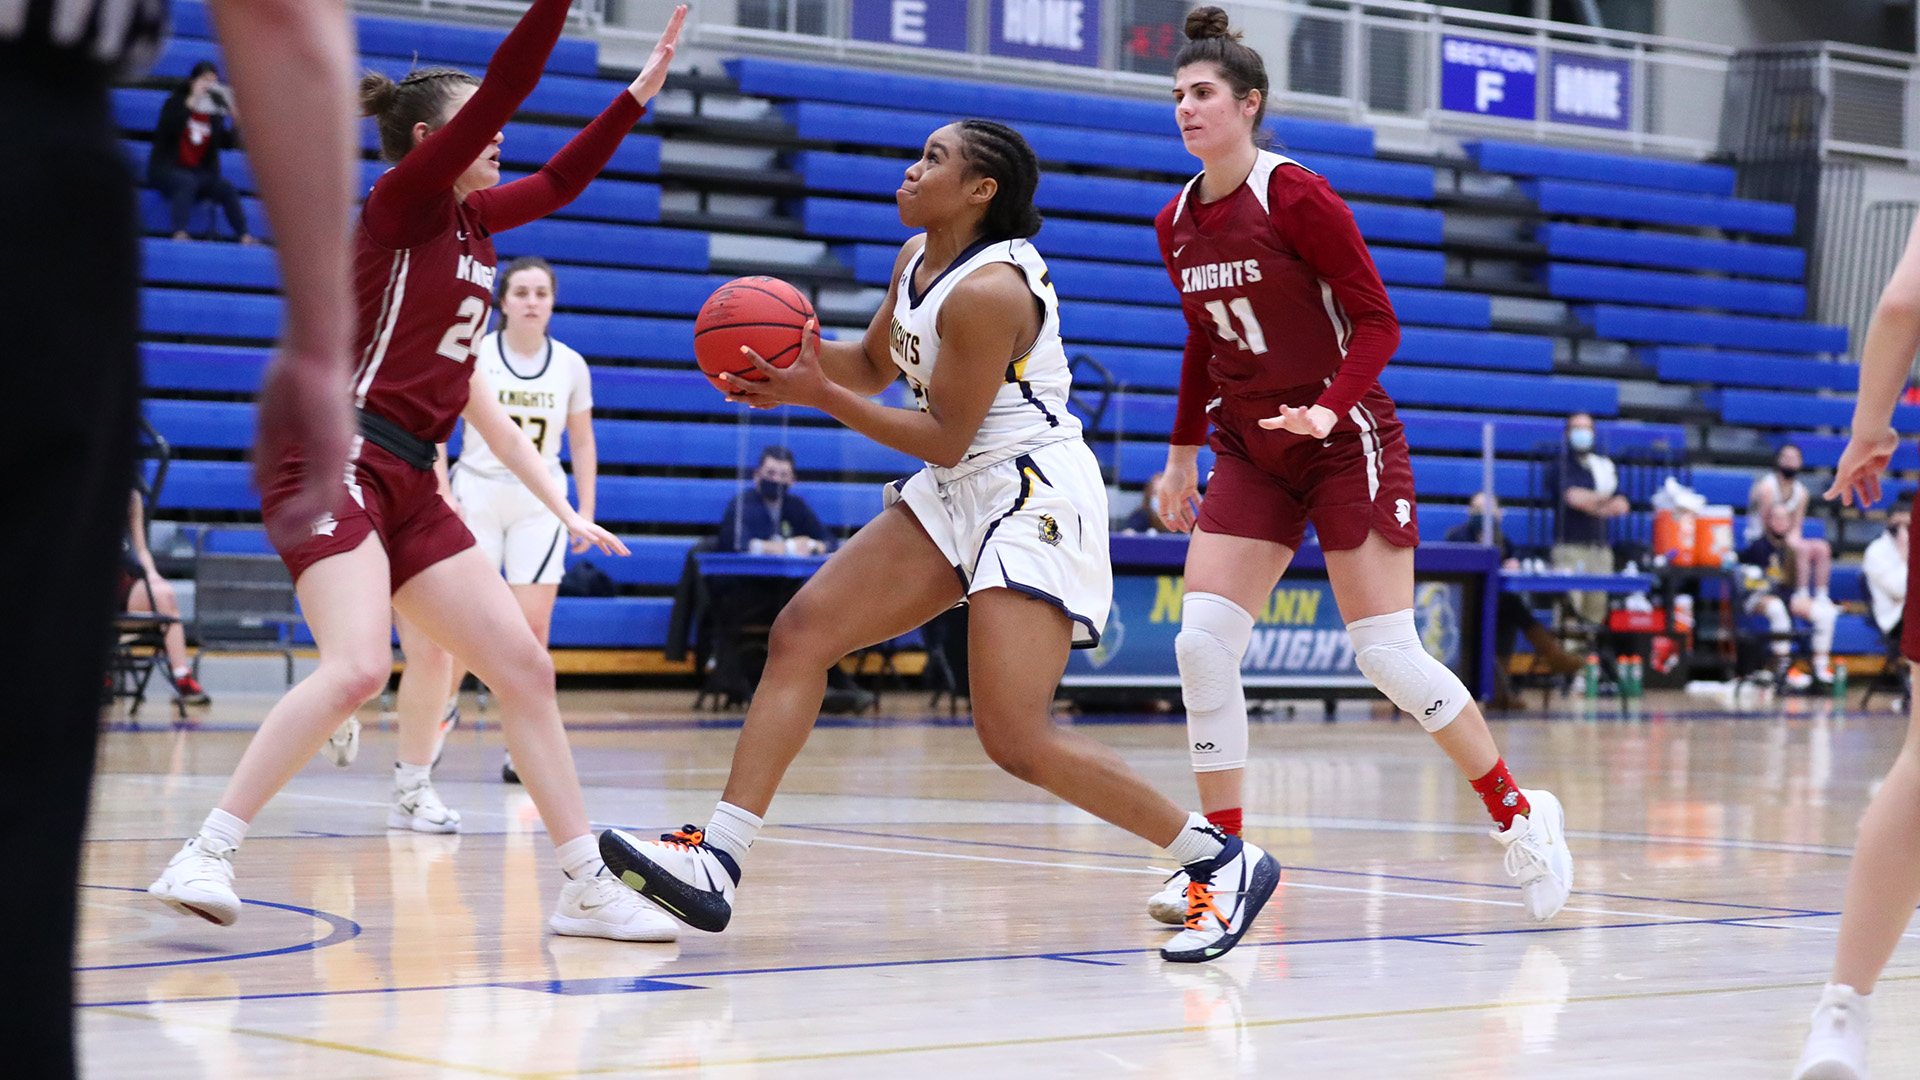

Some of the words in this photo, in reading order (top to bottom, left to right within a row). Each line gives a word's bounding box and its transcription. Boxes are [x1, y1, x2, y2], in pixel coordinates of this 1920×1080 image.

[891, 0, 927, 44] E
[1443, 39, 1537, 74] SECTION
[1475, 70, 1506, 113] F
[1555, 64, 1621, 120] HOME
[1181, 258, 1263, 293] KNIGHTS
[890, 316, 921, 367] NIGHTS
[498, 389, 555, 409] KNIGHTS
